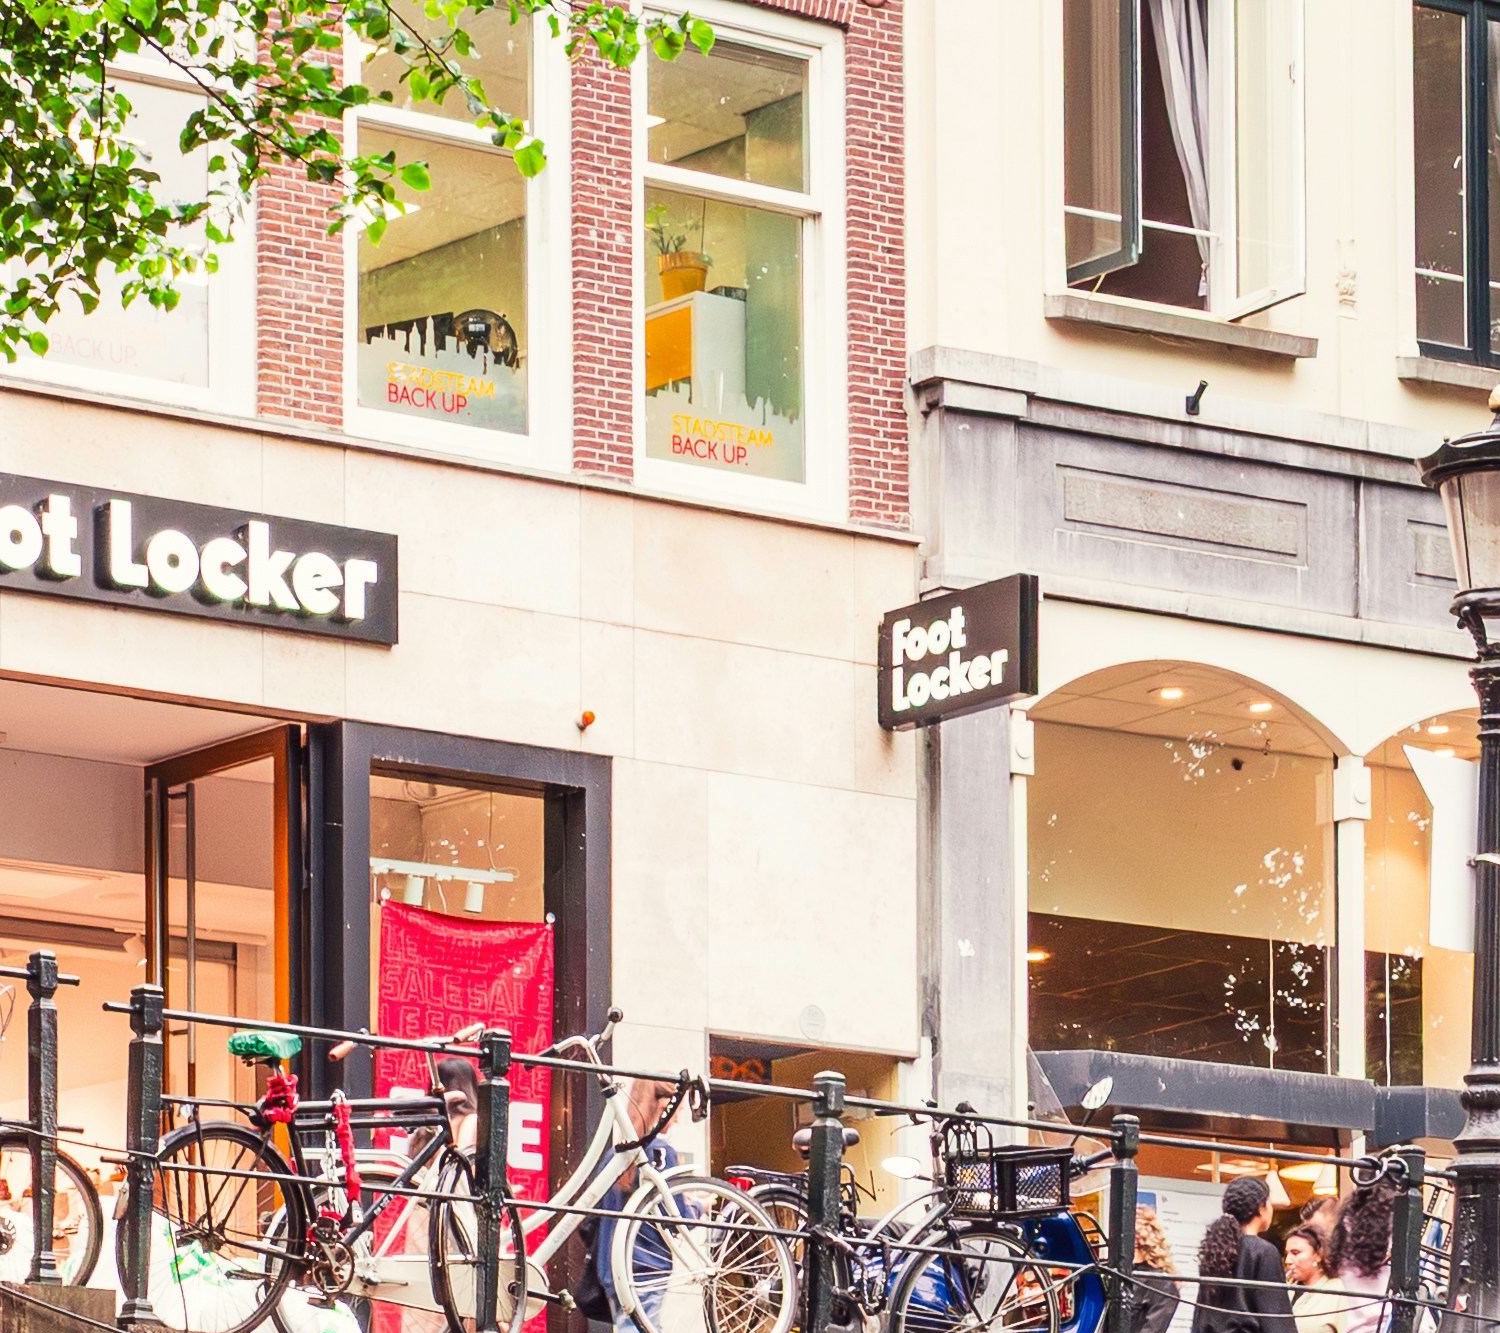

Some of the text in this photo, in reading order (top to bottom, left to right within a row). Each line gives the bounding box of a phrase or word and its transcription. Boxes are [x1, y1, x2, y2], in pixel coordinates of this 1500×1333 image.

[387, 362, 495, 401] STADSTEAM
[387, 383, 472, 417] BACK UP.
[671, 413, 774, 449] STADSTEAM
[672, 435, 750, 467] BACK UP.
[107, 498, 378, 621] Locker
[891, 605, 968, 667] Foot
[891, 648, 1009, 713] Locker
